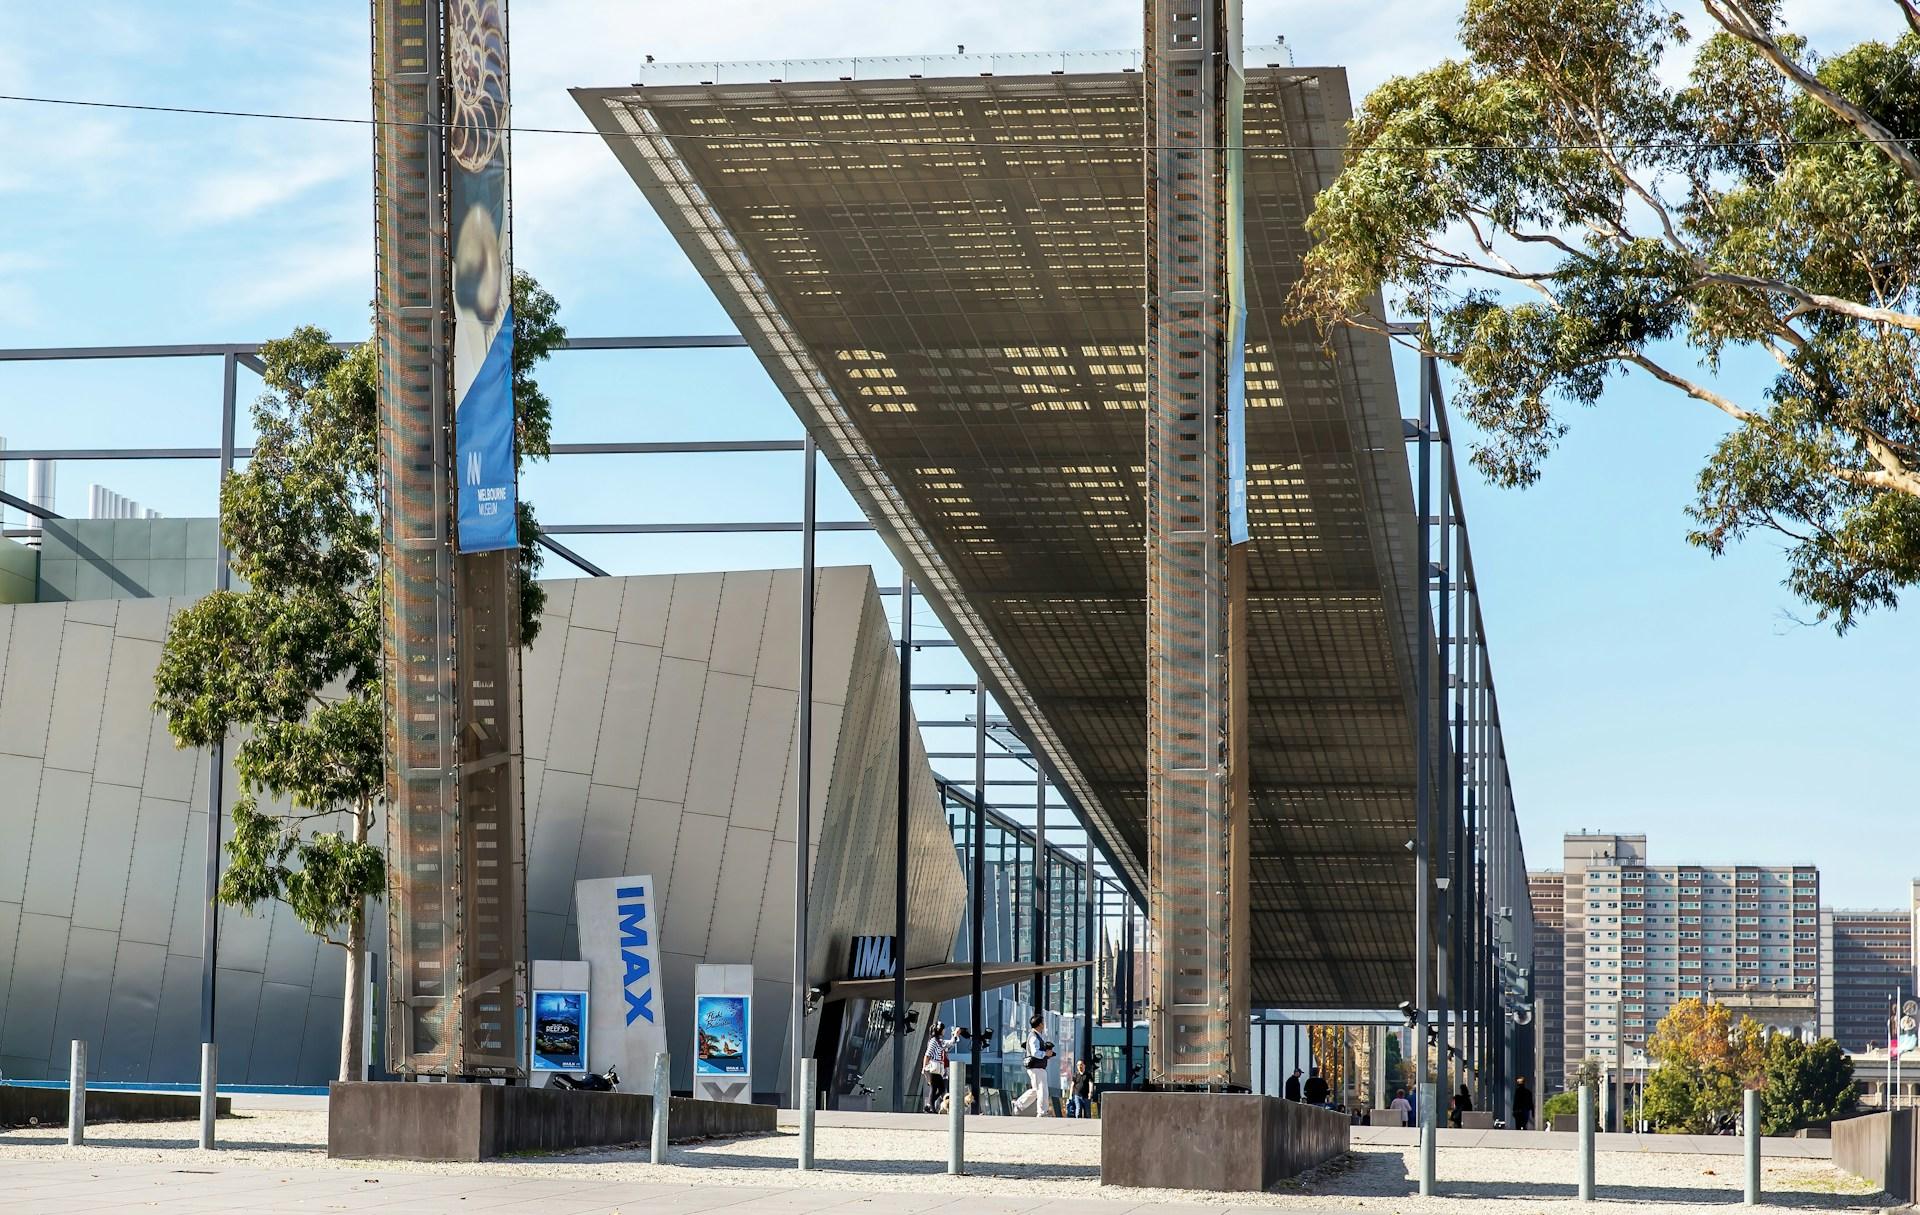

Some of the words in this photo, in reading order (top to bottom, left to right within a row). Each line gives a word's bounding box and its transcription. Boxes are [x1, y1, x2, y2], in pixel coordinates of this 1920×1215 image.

[478, 488, 506, 501] MELBOURNE
[479, 502, 498, 515] MUSEUM
[616, 886, 654, 1027] IMAX
